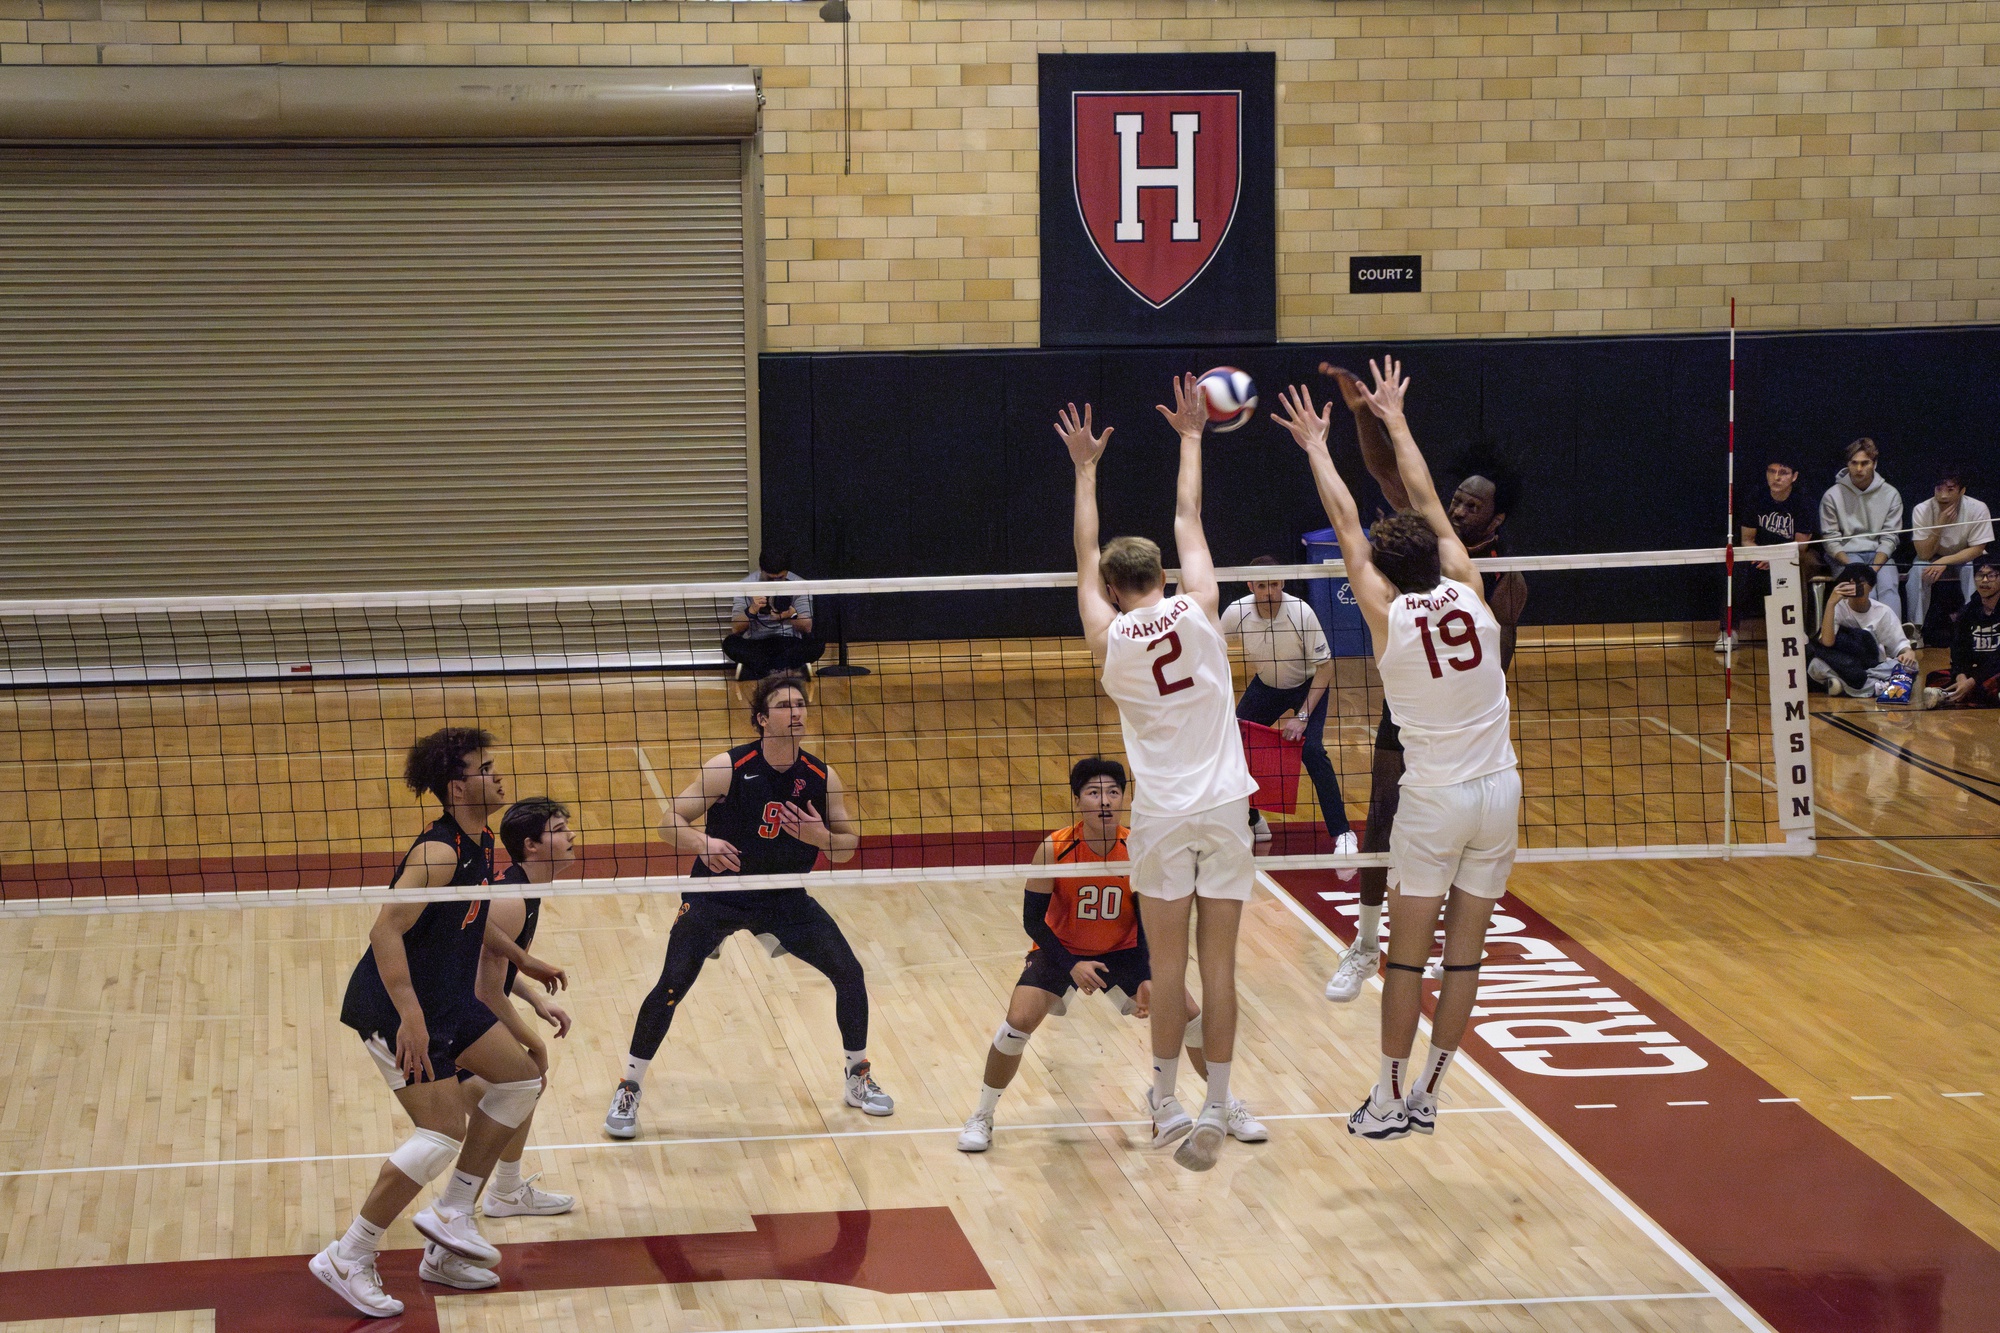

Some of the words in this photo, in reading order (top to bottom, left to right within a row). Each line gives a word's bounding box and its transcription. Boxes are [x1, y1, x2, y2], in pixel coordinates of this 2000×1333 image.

[1114, 111, 1201, 243] H
[1358, 268, 1402, 280] COURT
[1405, 268, 1413, 280] 2
[1146, 630, 1195, 697] 2
[1414, 609, 1483, 679] 19
[1781, 604, 1811, 817] CRIMSON
[757, 801, 783, 840] 9
[1076, 884, 1123, 921] 20
